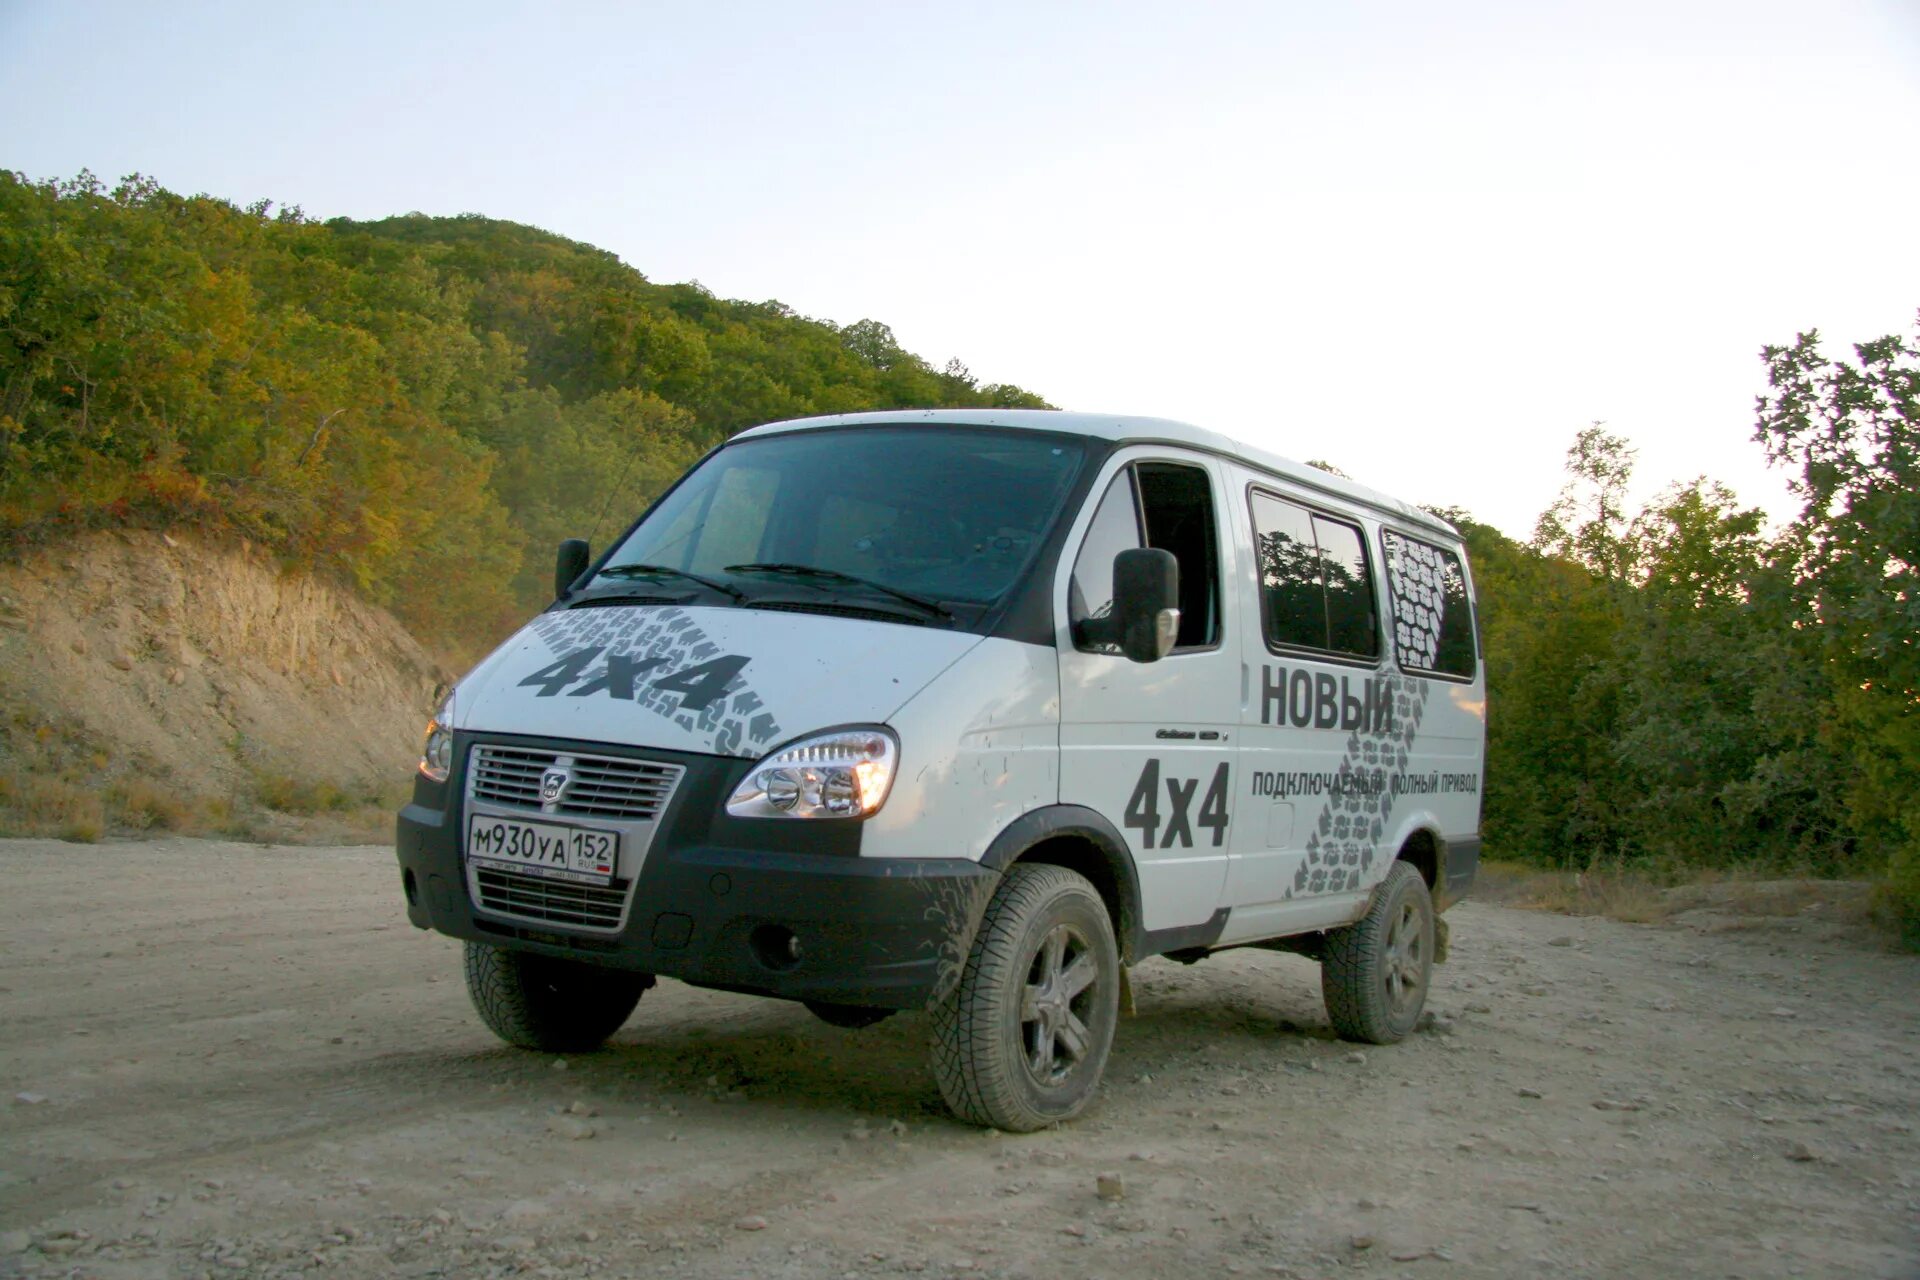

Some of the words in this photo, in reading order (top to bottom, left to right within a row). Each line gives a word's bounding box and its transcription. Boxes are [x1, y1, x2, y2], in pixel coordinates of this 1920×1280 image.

[1261, 664, 1394, 733] НОВЫЙ
[1391, 769, 1438, 796] ПОЛНЫЙ
[1440, 772, 1477, 795] ПРИВОД
[573, 832, 610, 861] 152
[578, 857, 597, 870] RUS
